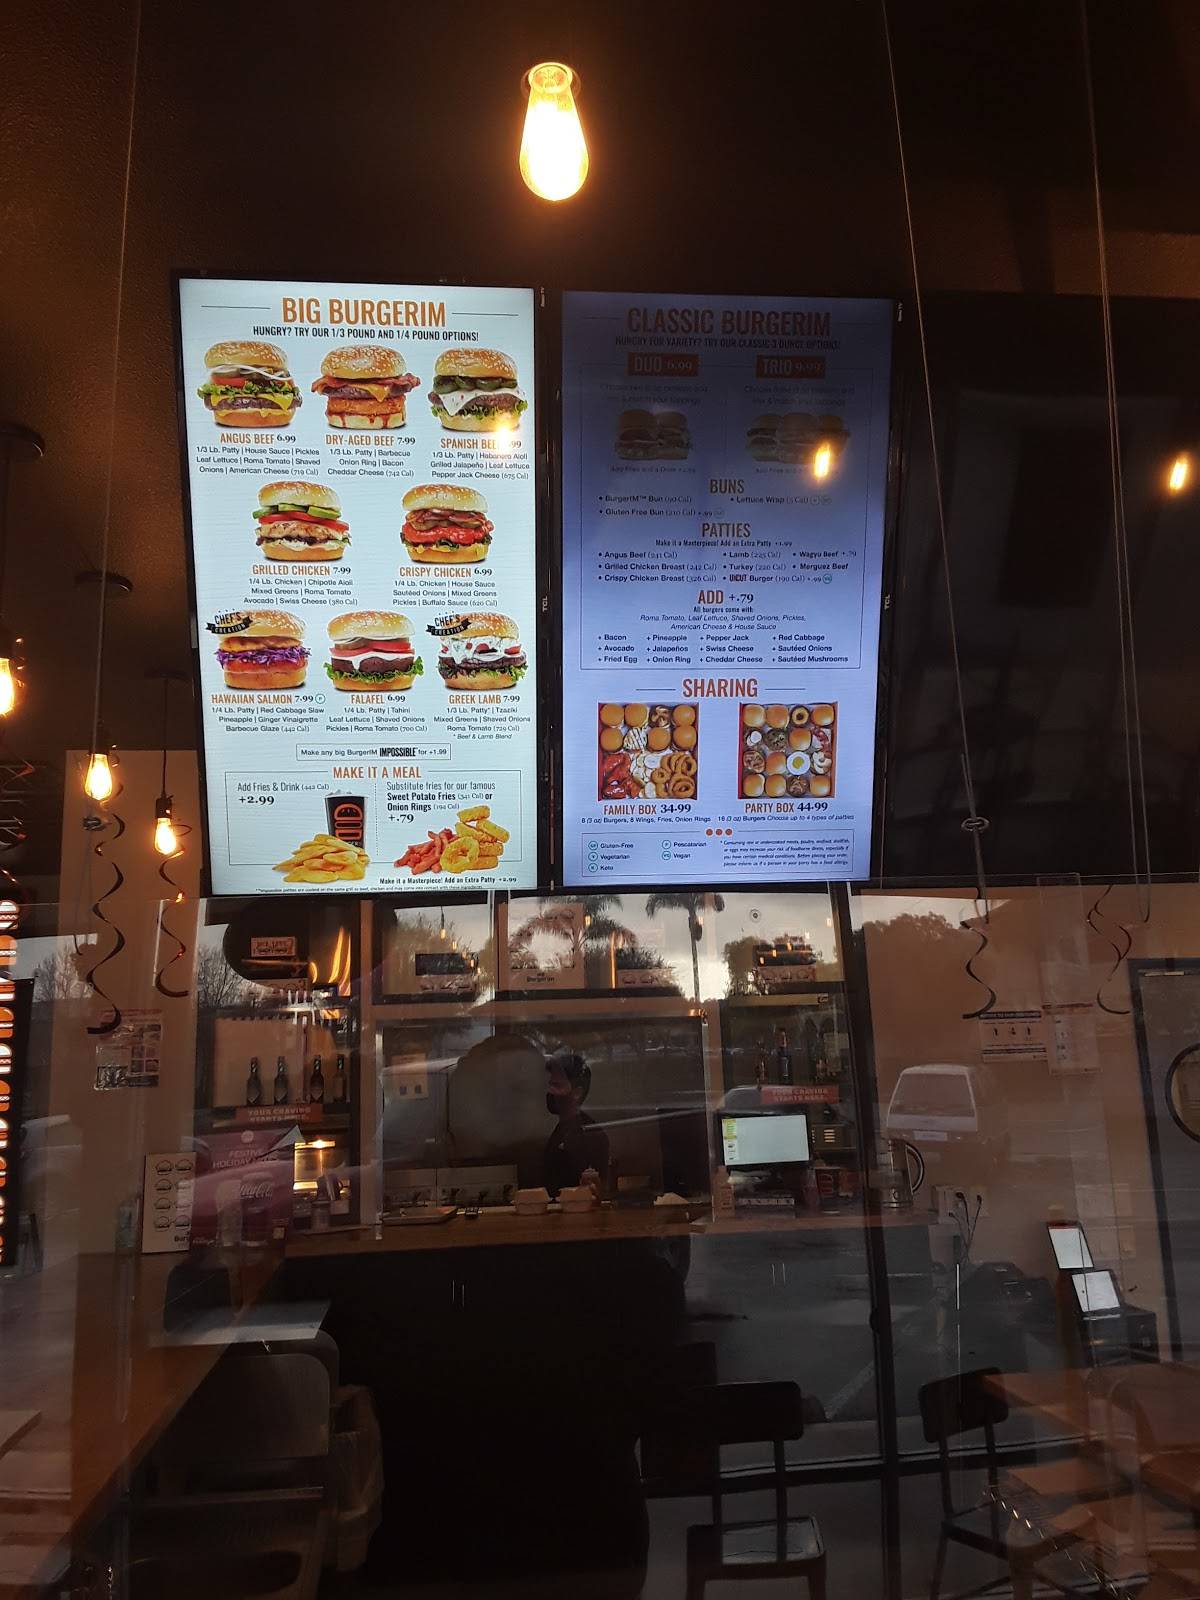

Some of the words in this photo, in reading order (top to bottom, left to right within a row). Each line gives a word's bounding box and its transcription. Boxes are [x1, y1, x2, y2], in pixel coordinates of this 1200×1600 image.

[283, 298, 320, 323] BIG
[329, 299, 445, 327] BURGERIM
[628, 307, 714, 334] CLASSIC
[721, 310, 831, 336] BURGERIM
[253, 326, 292, 336] HUNGRY?
[294, 327, 309, 336] TRY
[312, 328, 329, 337] OUR
[332, 328, 345, 338] 1/3
[348, 329, 375, 338] POUND
[378, 330, 394, 339] AND
[397, 330, 410, 339] 1/4
[412, 330, 440, 340] POUND
[443, 331, 479, 341] OPTIONS!
[634, 355, 662, 372] DUO
[762, 358, 792, 374] TRIO
[221, 433, 250, 443] ANGUS
[254, 434, 274, 444] BEEF
[277, 434, 296, 443] 6.99
[326, 435, 371, 445] DRY-AGED
[374, 436, 394, 446] BEEF
[398, 437, 415, 445] 7.99
[441, 439, 478, 449] SPANISH
[710, 479, 744, 493] BUNS
[702, 523, 750, 537] PATTIES
[253, 565, 288, 574] GRILLED
[292, 565, 330, 575] CHICKEN
[400, 567, 431, 576] CRISPY
[434, 567, 471, 577] CHICKEN
[730, 563, 753, 571] Turkey
[698, 590, 724, 604] ADD
[653, 634, 687, 642] Pineapple
[706, 634, 730, 642] Pepper
[795, 634, 825, 642] Cabbage
[624, 656, 637, 664] Egg
[675, 656, 691, 664] Ring
[683, 679, 757, 697] SHARING
[212, 695, 254, 704] HAWAIIAN
[258, 695, 292, 704] SALMON
[351, 695, 385, 704] FALAFEL
[387, 694, 405, 702] 6.99
[449, 695, 475, 704] GREEK
[478, 695, 501, 704] LAMB
[335, 749, 345, 757] big
[333, 766, 364, 778] MAKE
[368, 766, 377, 778] IT
[382, 766, 388, 778] A
[393, 766, 421, 778] MEAL
[238, 782, 250, 792] Add
[253, 782, 270, 792] Fries
[273, 782, 278, 792] &
[281, 782, 299, 792] Drink
[387, 781, 423, 790] Substitute
[426, 780, 440, 790] fries
[442, 781, 454, 790] for
[470, 781, 495, 790] famous
[239, 795, 274, 805] +2.99
[387, 792, 409, 800] Sweet
[412, 792, 435, 800] Potato
[438, 792, 456, 800] Fries
[388, 802, 407, 811] Onion
[411, 801, 431, 812] Rings
[604, 804, 635, 814] FAMILY
[638, 804, 656, 814] BOX
[661, 804, 691, 814] 34.99
[745, 803, 773, 813] PARTY
[776, 803, 794, 813] BOX
[797, 802, 828, 812] 44.99
[388, 814, 413, 823] +.79
